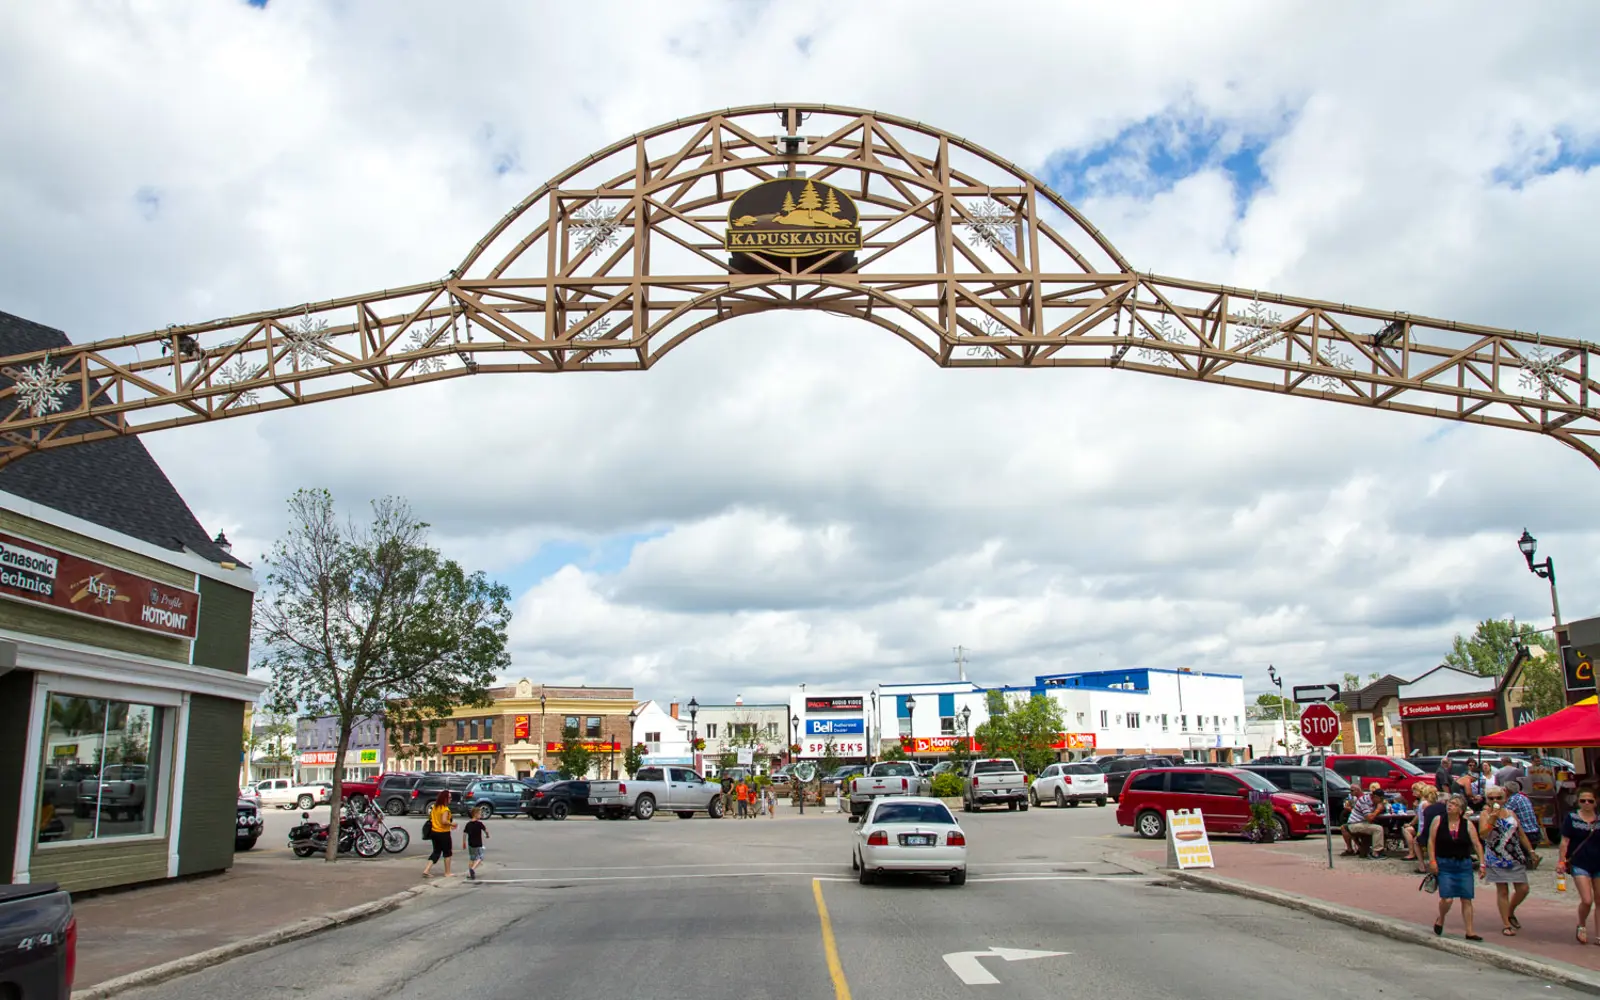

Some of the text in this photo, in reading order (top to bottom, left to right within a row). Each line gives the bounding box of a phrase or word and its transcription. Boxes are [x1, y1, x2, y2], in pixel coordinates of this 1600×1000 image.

[731, 231, 857, 246] KAPUSKASING
[141, 604, 188, 630] HOTPOINT
[813, 721, 833, 733] Bell
[1303, 717, 1337, 734] STOP
[809, 743, 863, 752] SPCEK'S
